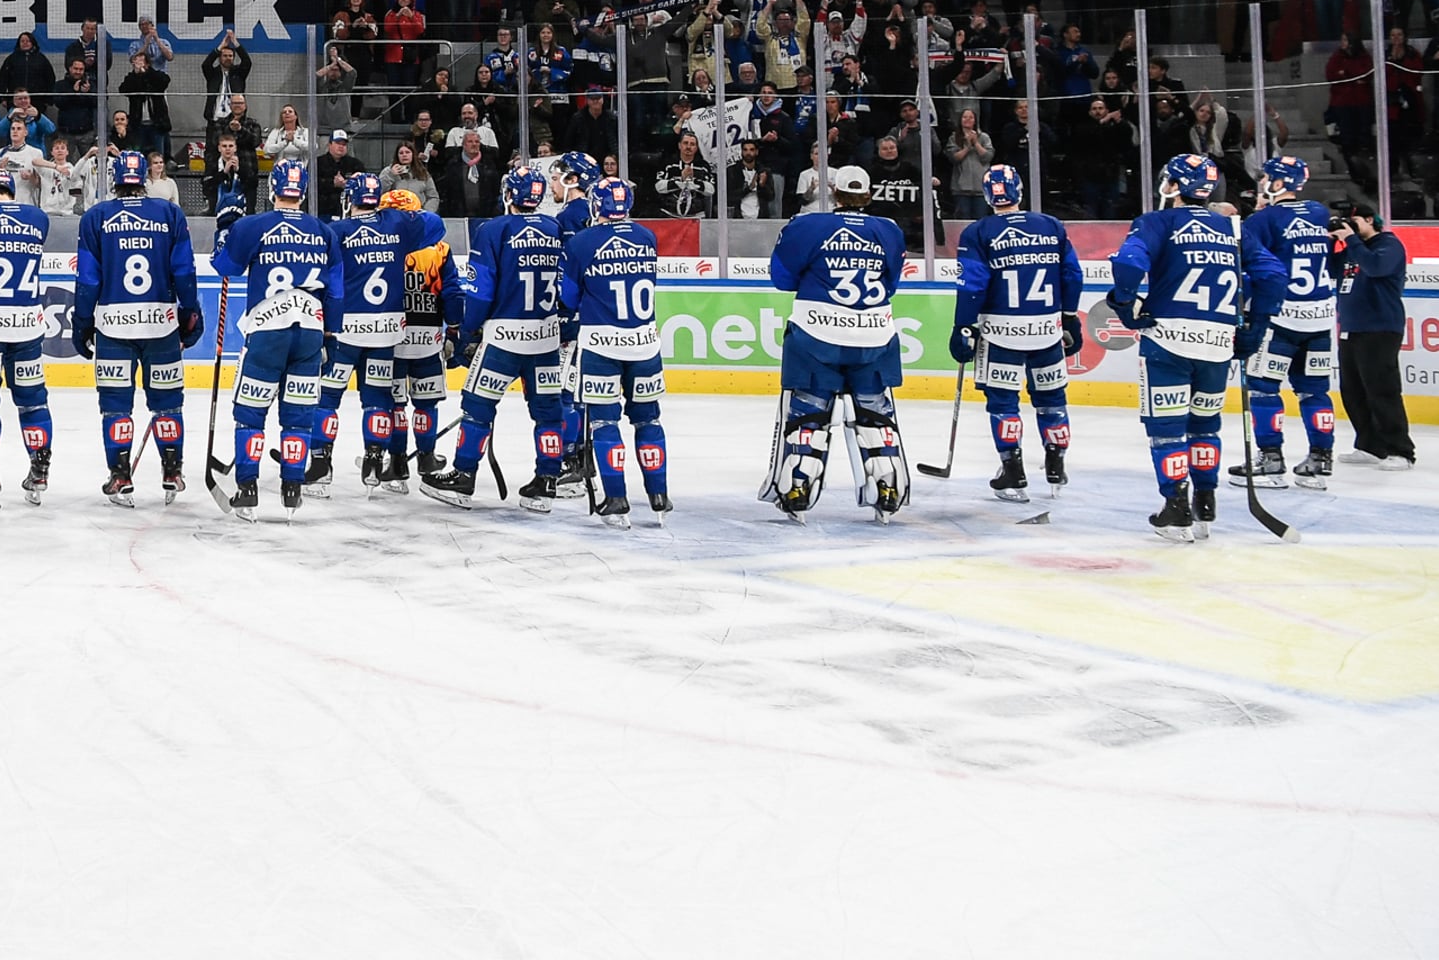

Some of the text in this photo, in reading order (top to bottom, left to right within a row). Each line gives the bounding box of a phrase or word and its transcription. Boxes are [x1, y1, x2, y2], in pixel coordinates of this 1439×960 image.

[872, 185, 919, 202] ZETT
[119, 237, 153, 249] RIEDI
[354, 251, 395, 264] WEBER
[518, 254, 559, 267] SIGRIST
[825, 257, 883, 271] WAEBER
[1183, 251, 1235, 267] TEXIER
[123, 254, 152, 295] 8
[1288, 258, 1332, 295] 54
[363, 267, 388, 305] 6
[519, 271, 558, 311] 13
[828, 270, 886, 306] 35
[1002, 268, 1053, 308] 14
[1173, 268, 1238, 315] 42
[609, 279, 655, 320] 10
[807, 310, 887, 328] SwissLife
[983, 318, 1056, 337] SwissLife
[1154, 324, 1231, 348] SwissLife
[1268, 359, 1288, 373] ewz
[1309, 357, 1330, 367] ewz
[16, 364, 41, 377] ewz
[97, 366, 124, 378] ewz
[152, 367, 180, 381] ewz
[367, 364, 391, 377] ewz
[538, 371, 560, 384] ewz
[991, 369, 1018, 382] ewz
[1036, 368, 1063, 383] ewz
[241, 382, 271, 399] ewz
[287, 380, 315, 394] ewz
[479, 374, 508, 391] ewz
[584, 380, 615, 394] ewz
[635, 378, 662, 394] ewz
[1154, 390, 1187, 407] ewz
[1193, 394, 1223, 408] ewz
